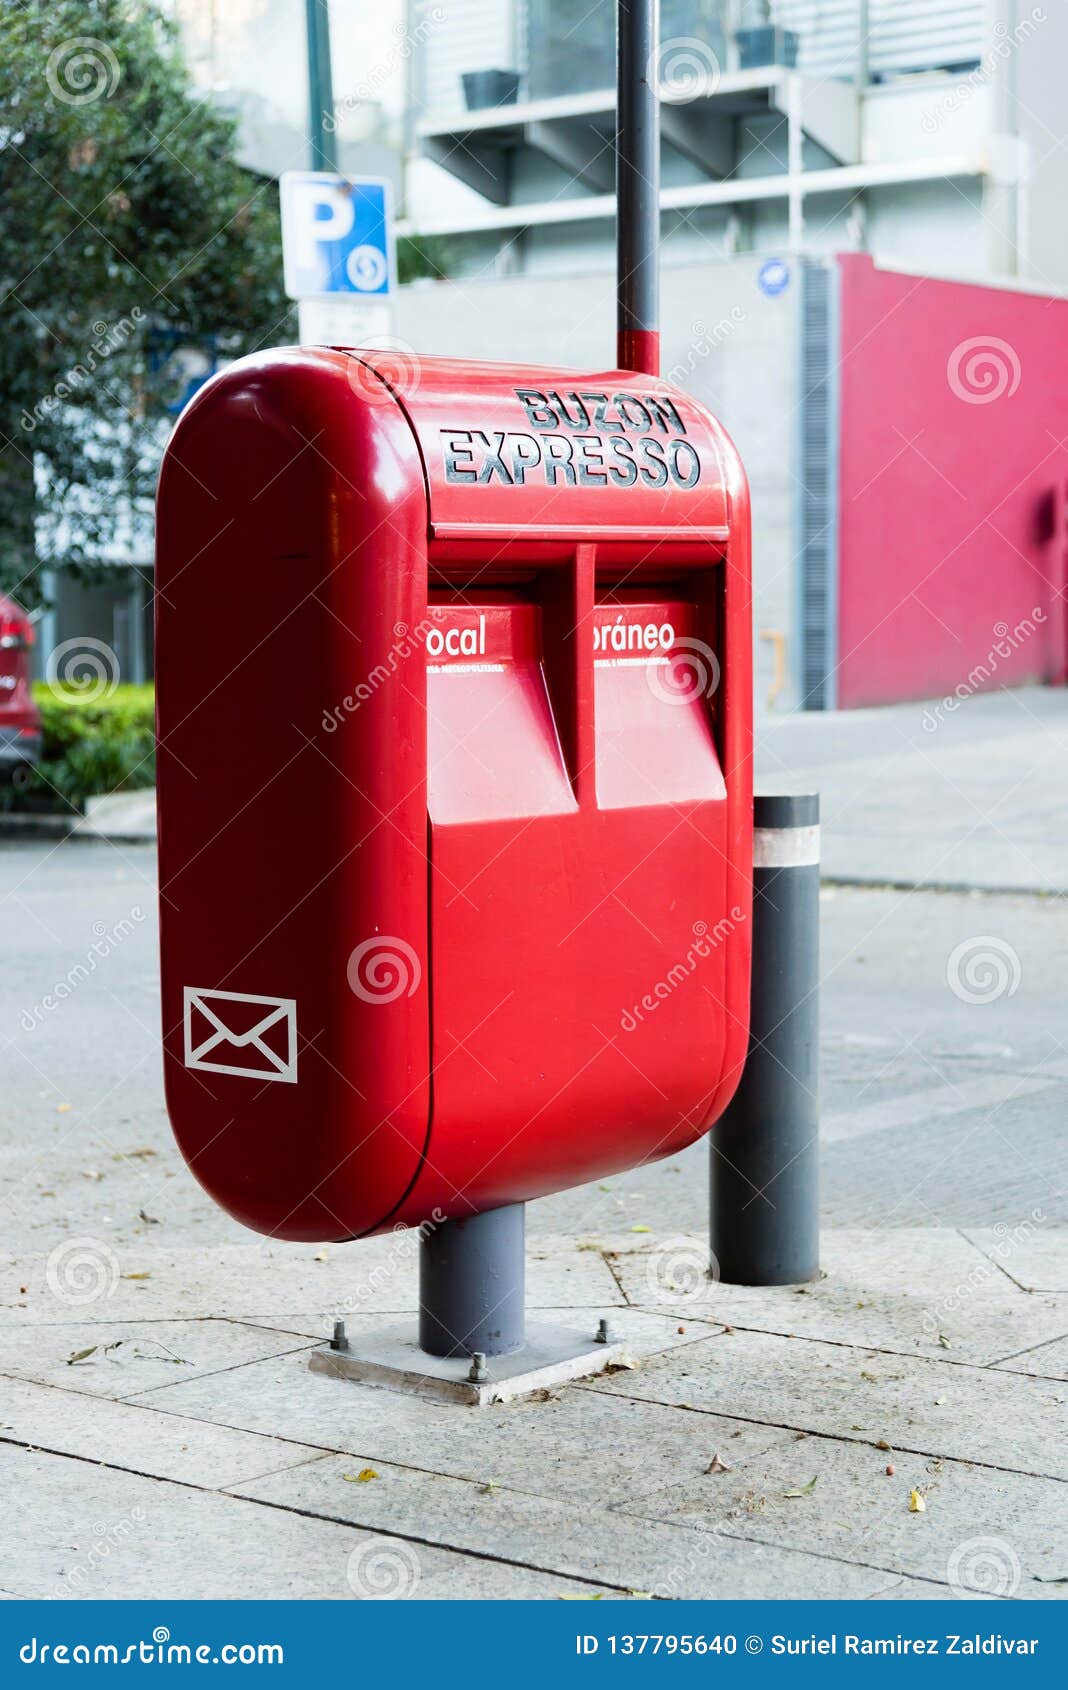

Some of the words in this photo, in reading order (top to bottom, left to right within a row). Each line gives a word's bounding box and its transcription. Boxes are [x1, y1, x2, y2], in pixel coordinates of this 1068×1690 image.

[293, 184, 355, 270] P
[513, 388, 686, 435] BUZON
[439, 429, 701, 489] EXPRESSO
[426, 614, 486, 655] ocal
